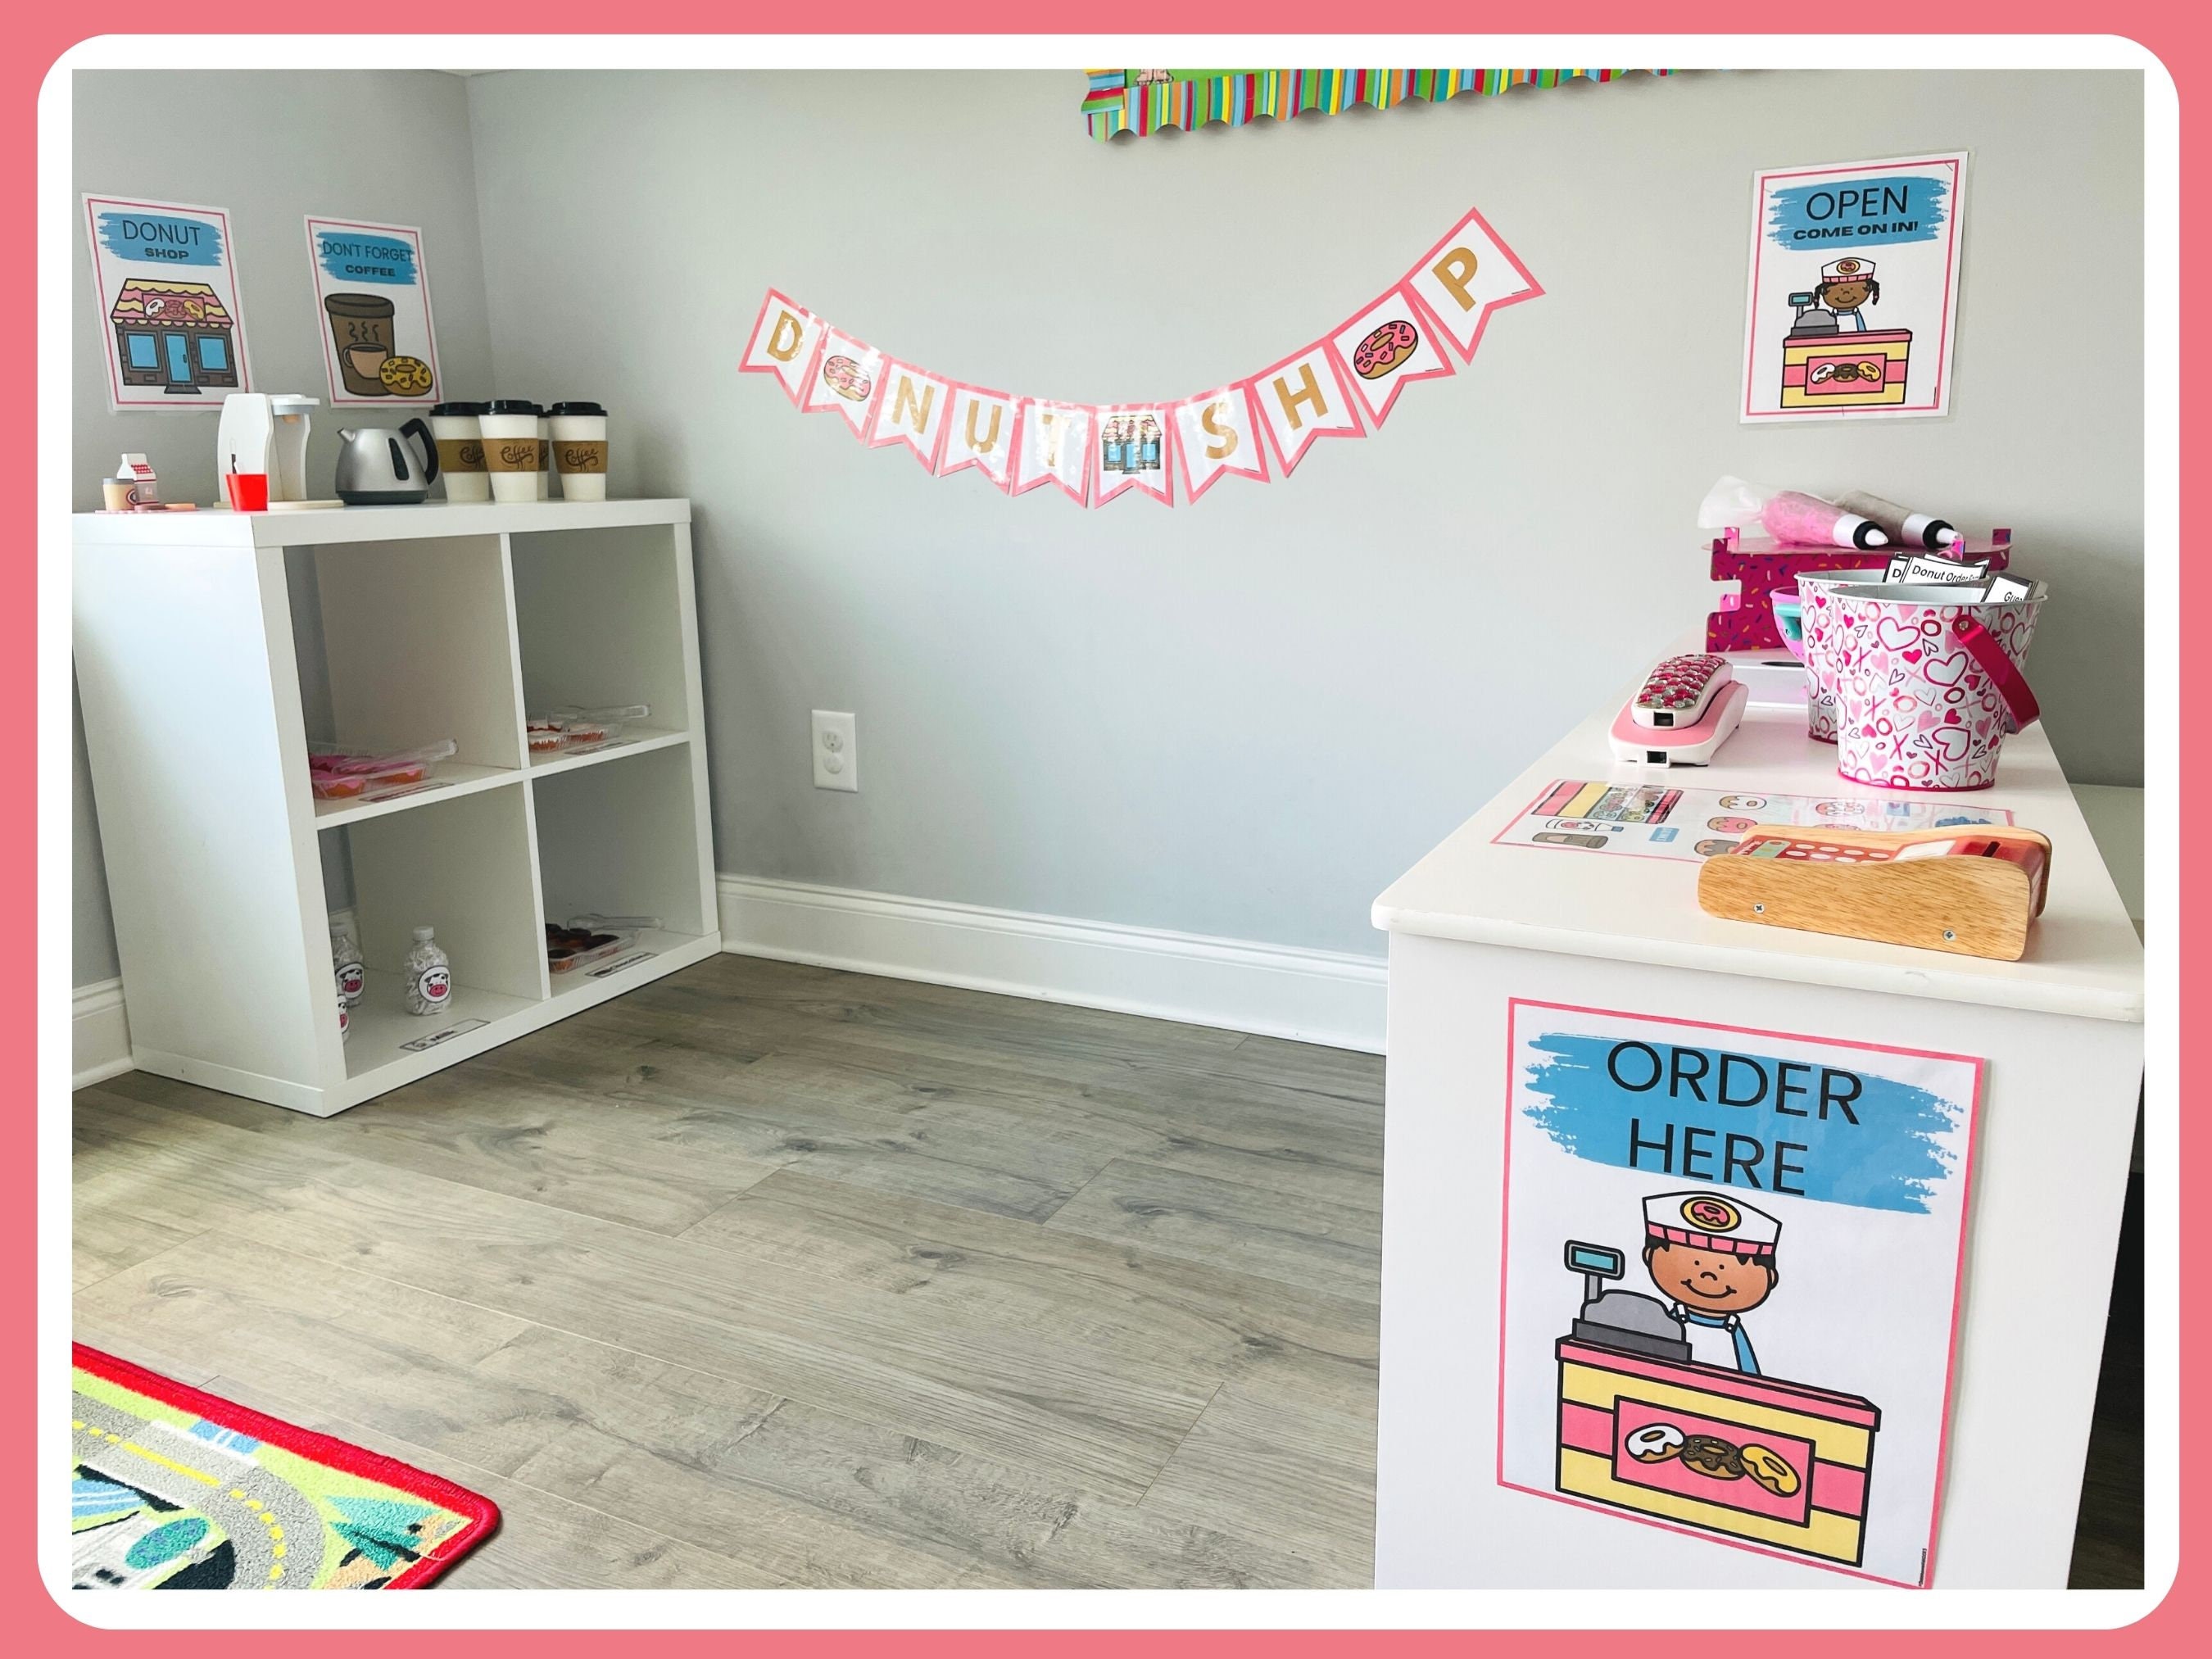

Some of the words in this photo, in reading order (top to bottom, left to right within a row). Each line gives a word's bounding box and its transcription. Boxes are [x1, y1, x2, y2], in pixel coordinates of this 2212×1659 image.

[1806, 184, 1908, 221] OPEN
[122, 220, 201, 246] DONUT
[1793, 226, 1853, 240] COME
[1857, 223, 1888, 234] ON
[1891, 221, 1919, 233] IN!
[144, 247, 189, 260] SHOP
[322, 241, 361, 256] DON'T
[365, 245, 413, 262] FORGET
[345, 264, 396, 277] COFFEE
[500, 445, 535, 470] Coffee
[565, 447, 599, 472] Coffee
[1912, 565, 1946, 581] Donut
[1607, 1040, 1863, 1126] ORDER
[1629, 1117, 1809, 1196] HERE
